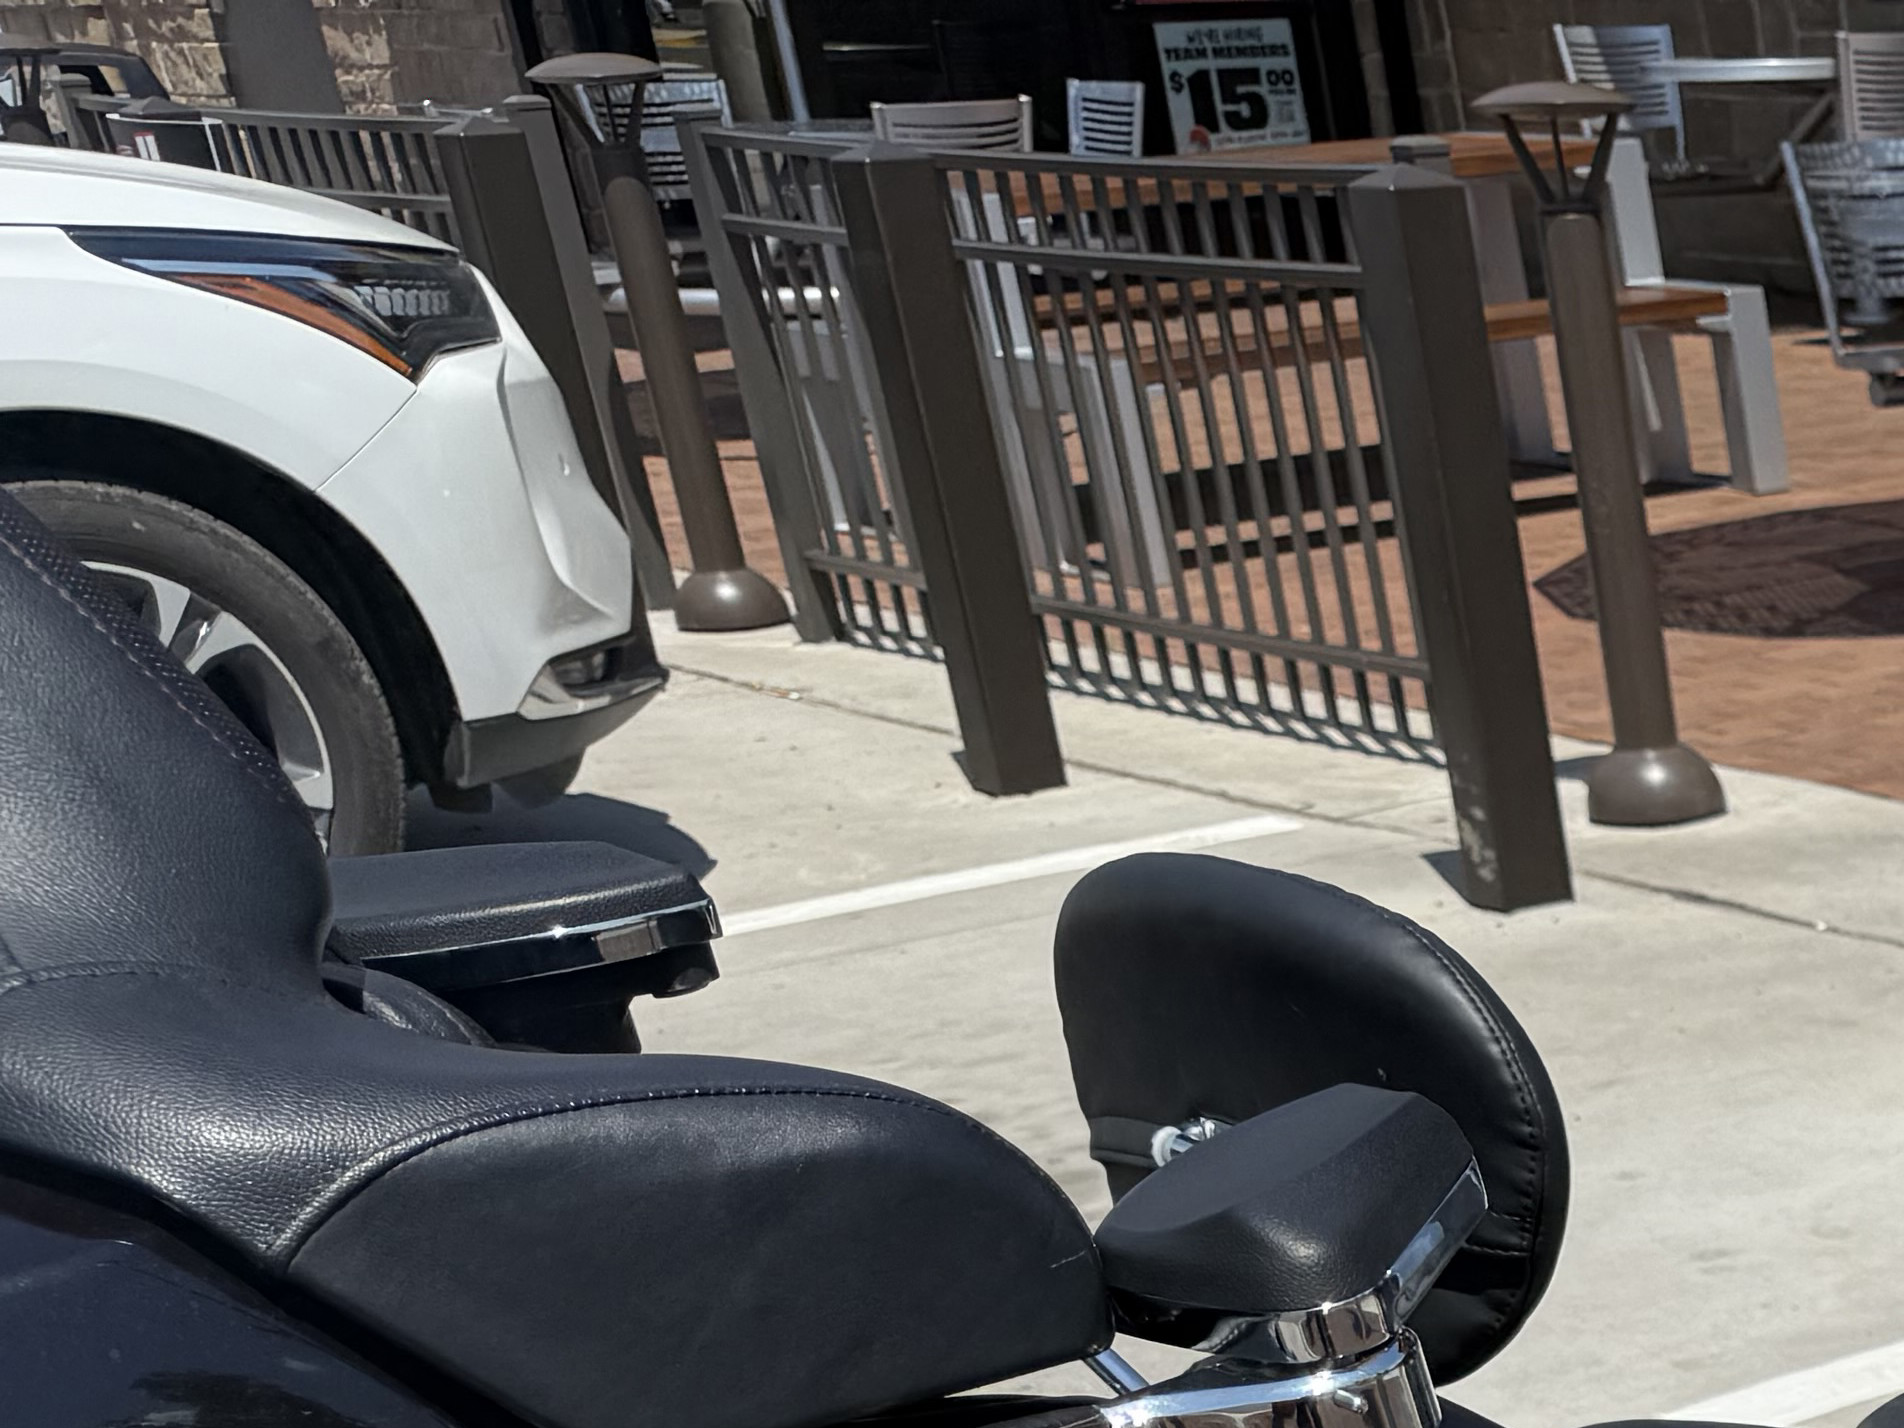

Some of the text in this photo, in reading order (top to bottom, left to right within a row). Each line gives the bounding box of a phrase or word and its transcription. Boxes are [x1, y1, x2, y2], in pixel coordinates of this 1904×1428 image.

[1163, 43, 1290, 62] TEAM MEMBERS
[1266, 69, 1295, 86] 00
